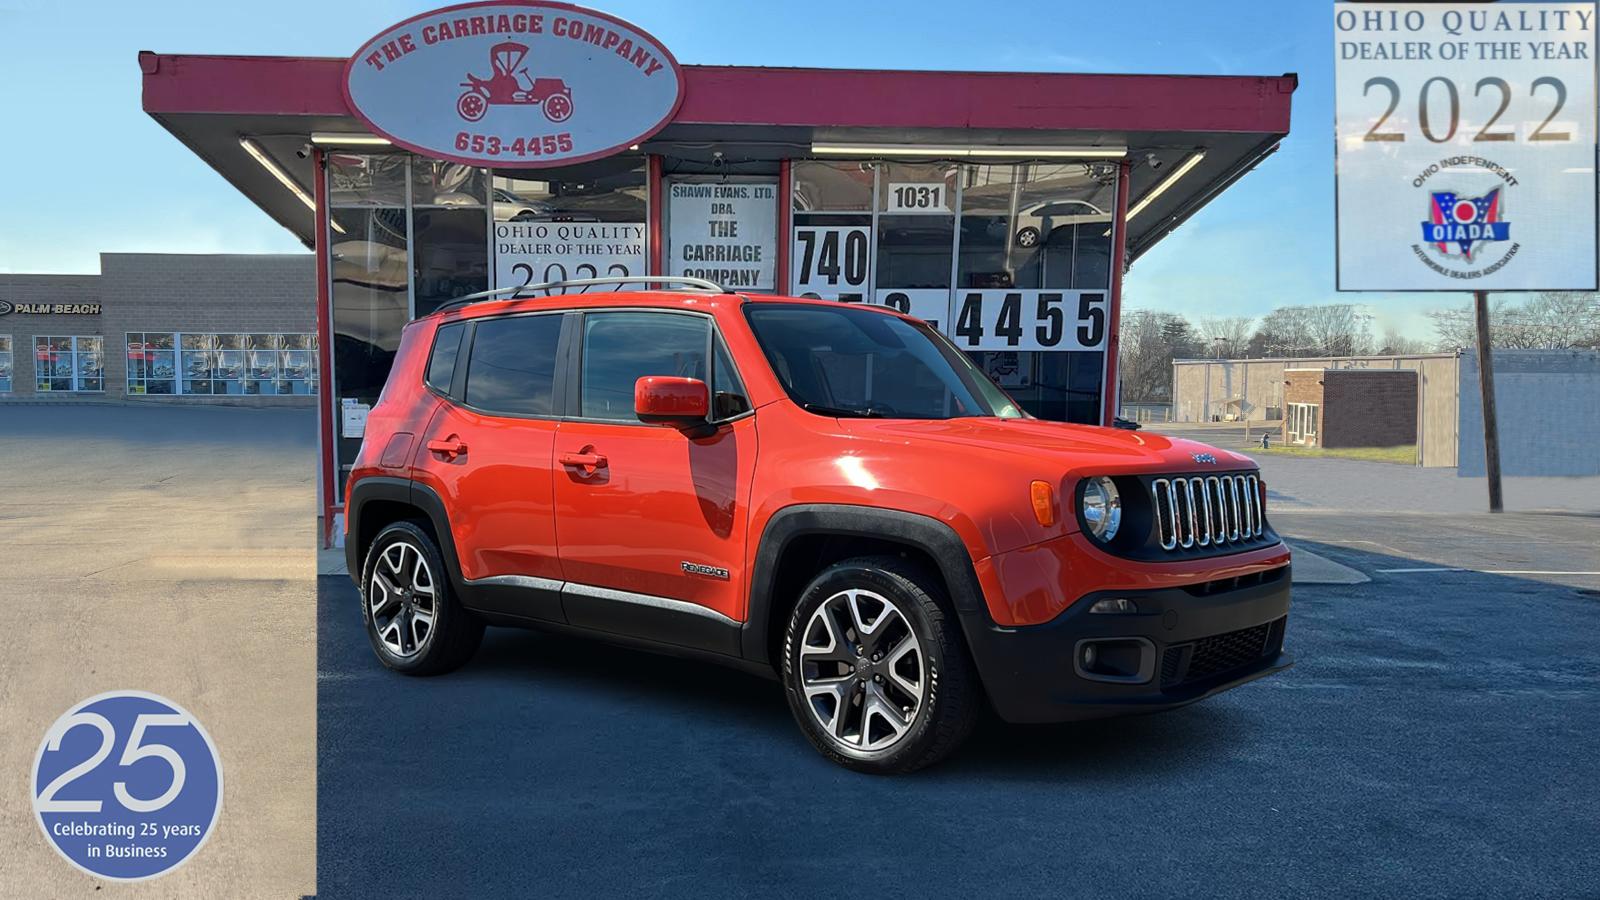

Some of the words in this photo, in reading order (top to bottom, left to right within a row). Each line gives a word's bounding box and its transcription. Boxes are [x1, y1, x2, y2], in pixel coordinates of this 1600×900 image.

[1336, 10, 1425, 32] OHIO
[1442, 10, 1592, 36] QUALITY
[365, 33, 416, 72] THE
[423, 14, 543, 45] CARRIAGE
[552, 16, 664, 77] COMPANY
[1340, 41, 1433, 60] DEALER
[1438, 41, 1469, 60] OF
[1475, 41, 1521, 60] THE
[1528, 41, 1589, 60] YEAR
[1362, 76, 1571, 143] 2022
[455, 132, 573, 156] 653-4455
[1412, 163, 1439, 188] OHIO
[1440, 156, 1519, 187] INDEPENDENT
[672, 186, 712, 198] SHAWN
[754, 187, 775, 199] LTD.
[894, 186, 941, 208] 1031
[711, 203, 736, 215] DBA.
[496, 225, 549, 239] OHIO
[557, 225, 644, 242] QUALITY
[708, 220, 738, 238] THE
[1432, 224, 1496, 240] OIADA
[499, 243, 552, 255] DEALER
[555, 243, 573, 255] OF
[576, 243, 604, 255] THE
[606, 243, 642, 255] YEAR
[682, 244, 762, 262] CARRIAGE
[797, 229, 868, 286] 740
[1411, 243, 1450, 277] AUTOMOBILE
[1449, 269, 1482, 280] DEALERS
[1482, 242, 1520, 276] ASSOCIATION
[14, 303, 51, 314] PALM
[54, 303, 100, 314] BEACH
